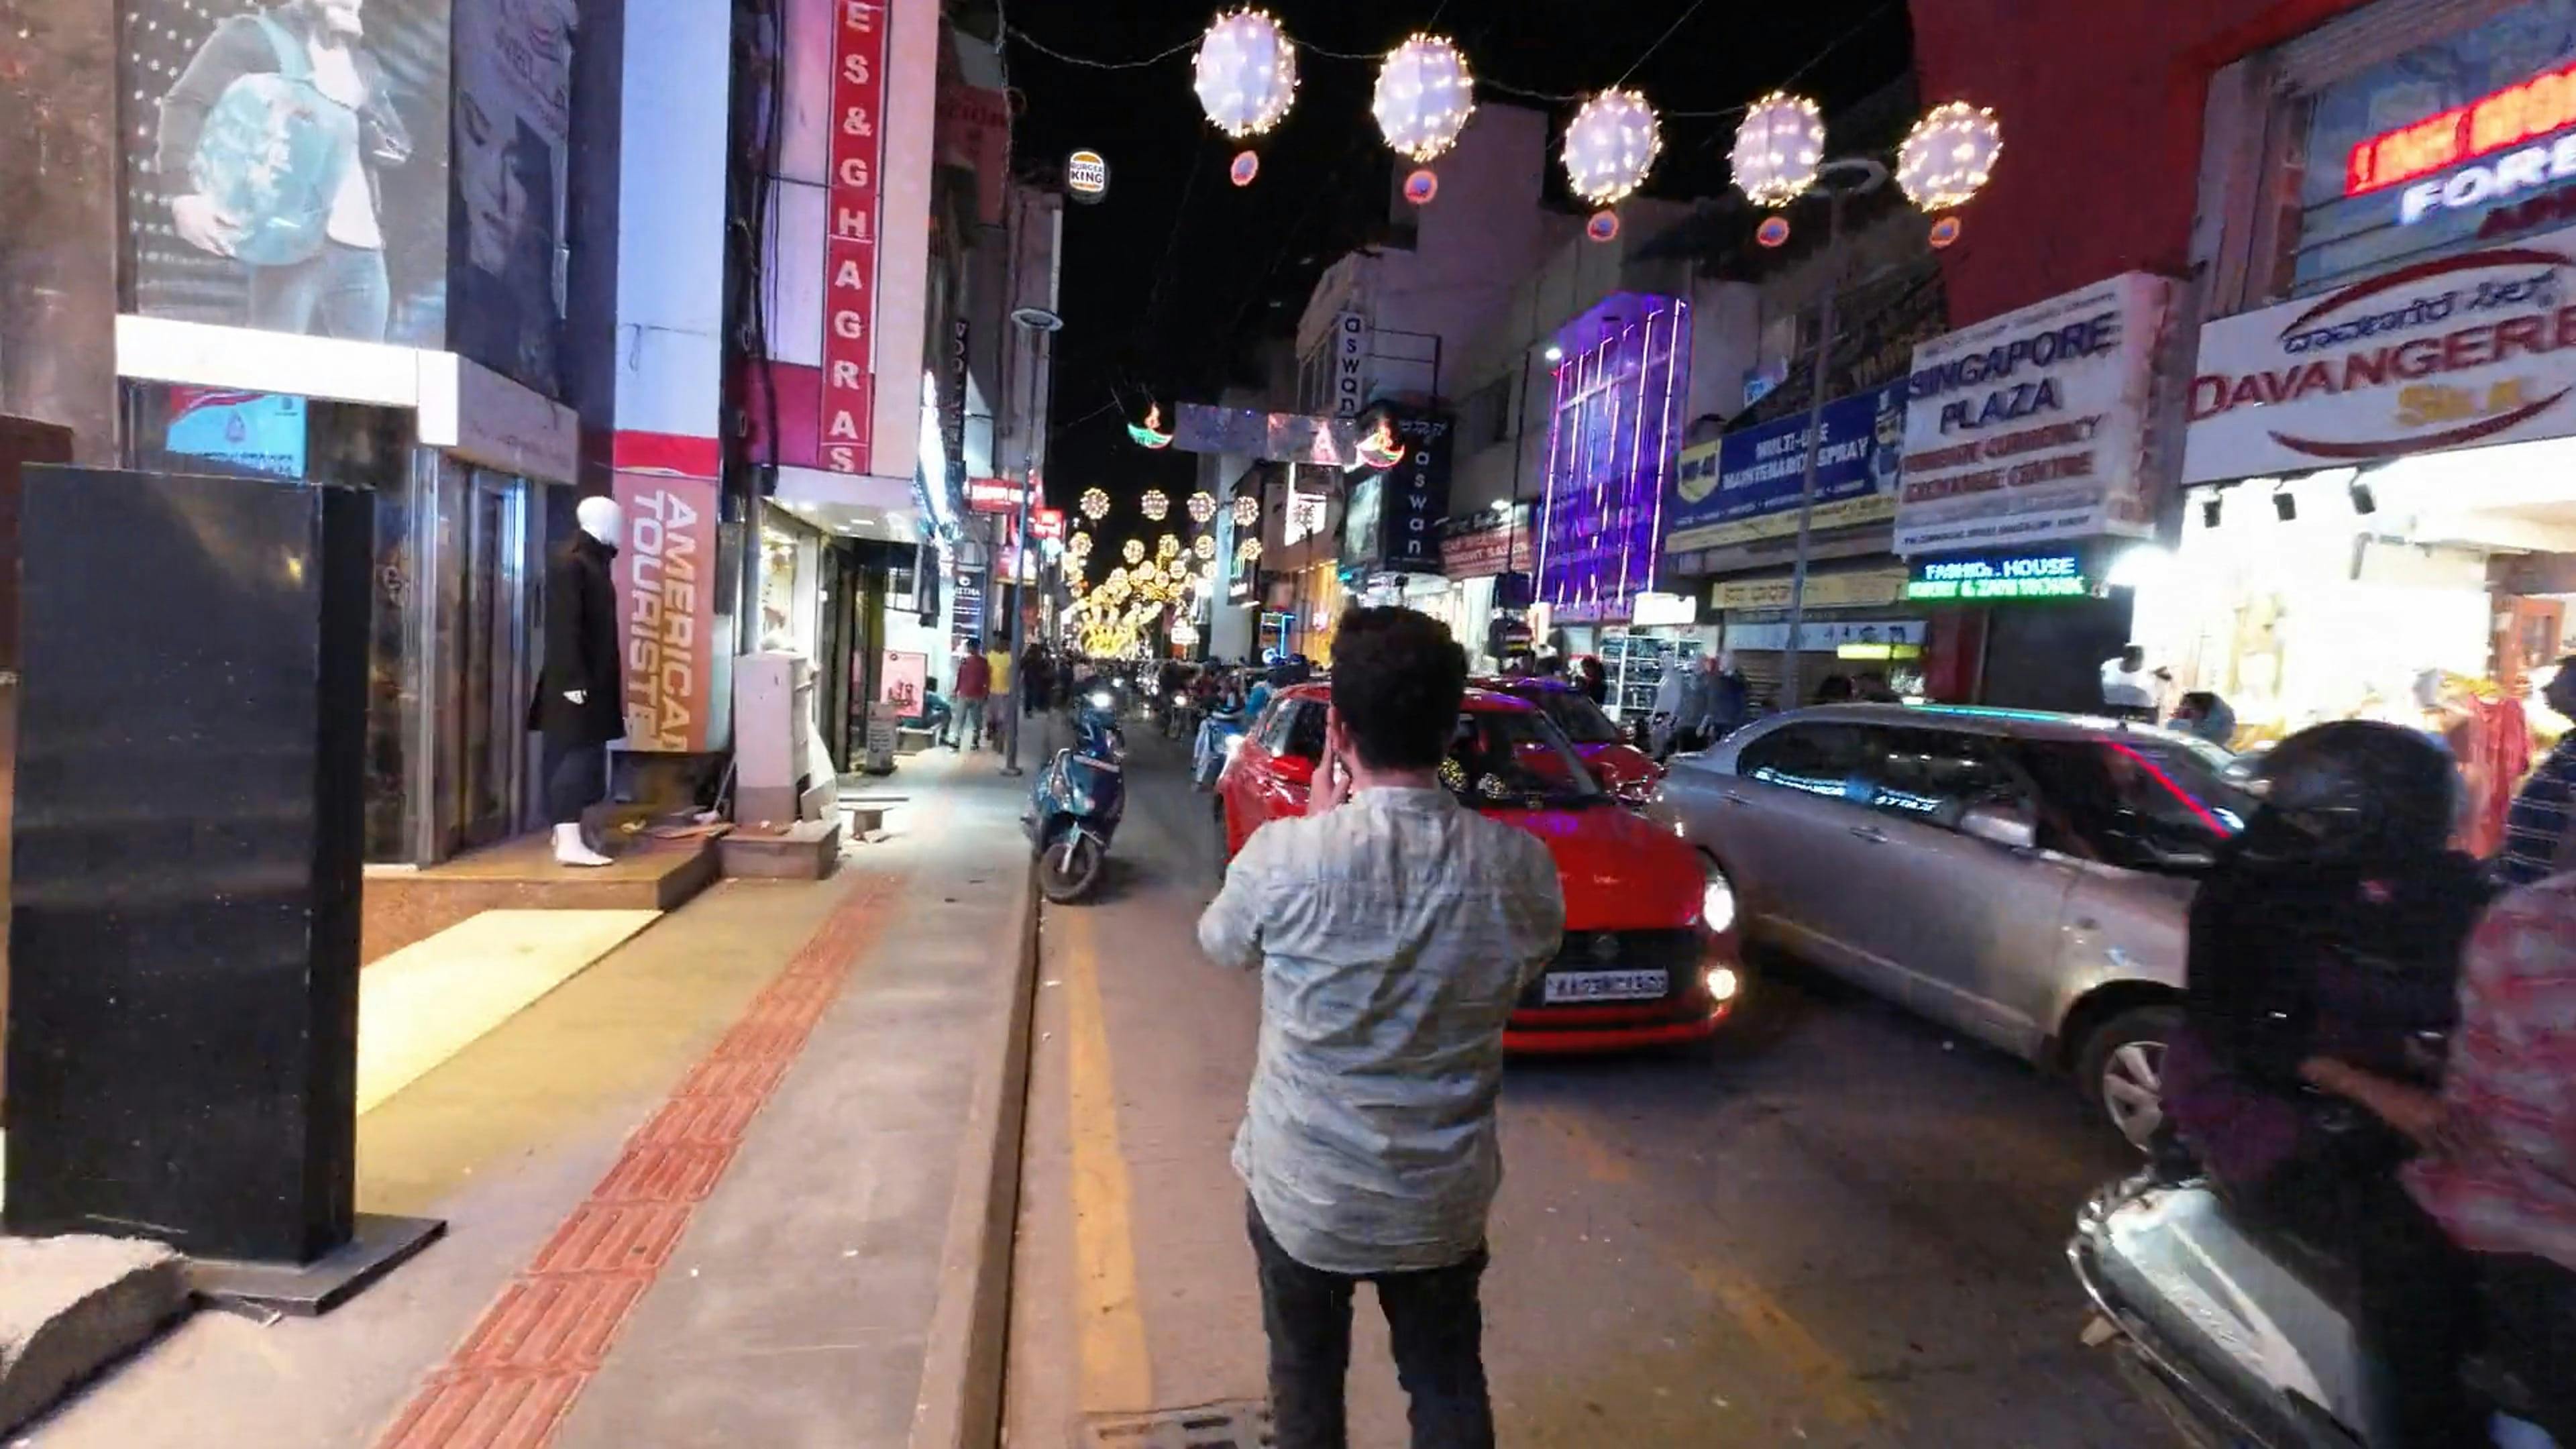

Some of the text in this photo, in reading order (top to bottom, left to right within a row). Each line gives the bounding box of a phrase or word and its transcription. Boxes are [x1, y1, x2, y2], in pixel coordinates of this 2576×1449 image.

[843, 107, 872, 136] &
[1071, 171, 1103, 183] KING
[829, 158, 869, 472] GHAGRAS
[1340, 317, 1360, 413] aswan
[1909, 311, 2123, 397] SINGAPORE
[1940, 378, 2059, 434] PLAZA
[1722, 452, 1810, 492] MAINTENANC
[1817, 437, 1869, 468] SPRAY
[1756, 423, 1829, 462] MULTI-UE
[1409, 450, 1430, 554] aswan
[2003, 557, 2075, 578] HOUSE
